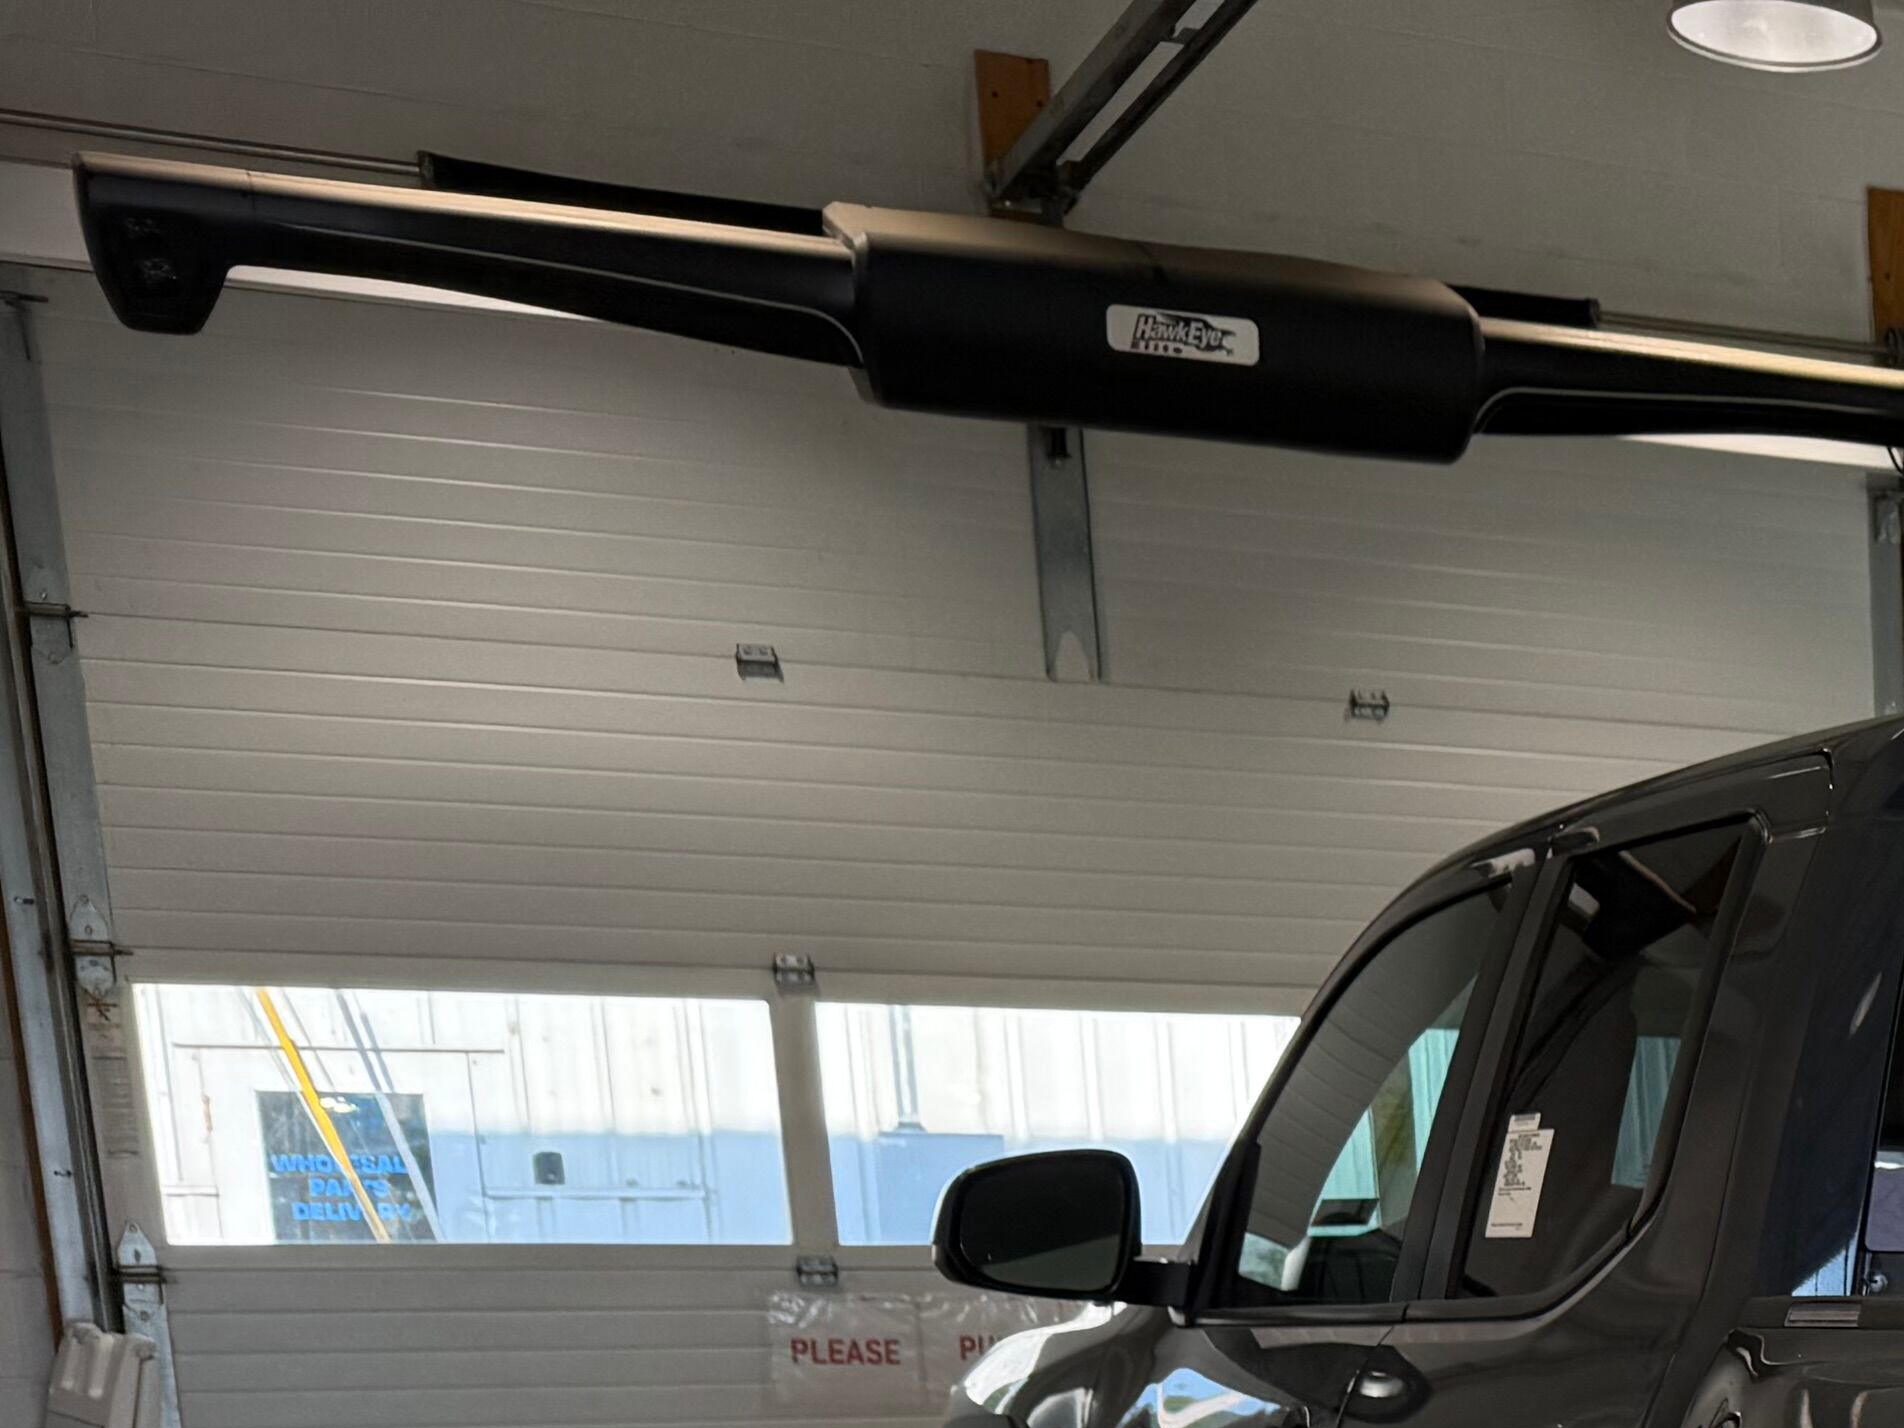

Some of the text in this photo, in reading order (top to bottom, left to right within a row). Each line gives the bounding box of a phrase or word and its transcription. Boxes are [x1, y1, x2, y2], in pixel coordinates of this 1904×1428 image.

[1133, 314, 1222, 349] HawkEye
[291, 1201, 412, 1221] DELIVRY
[790, 1337, 902, 1365] PLEASE
